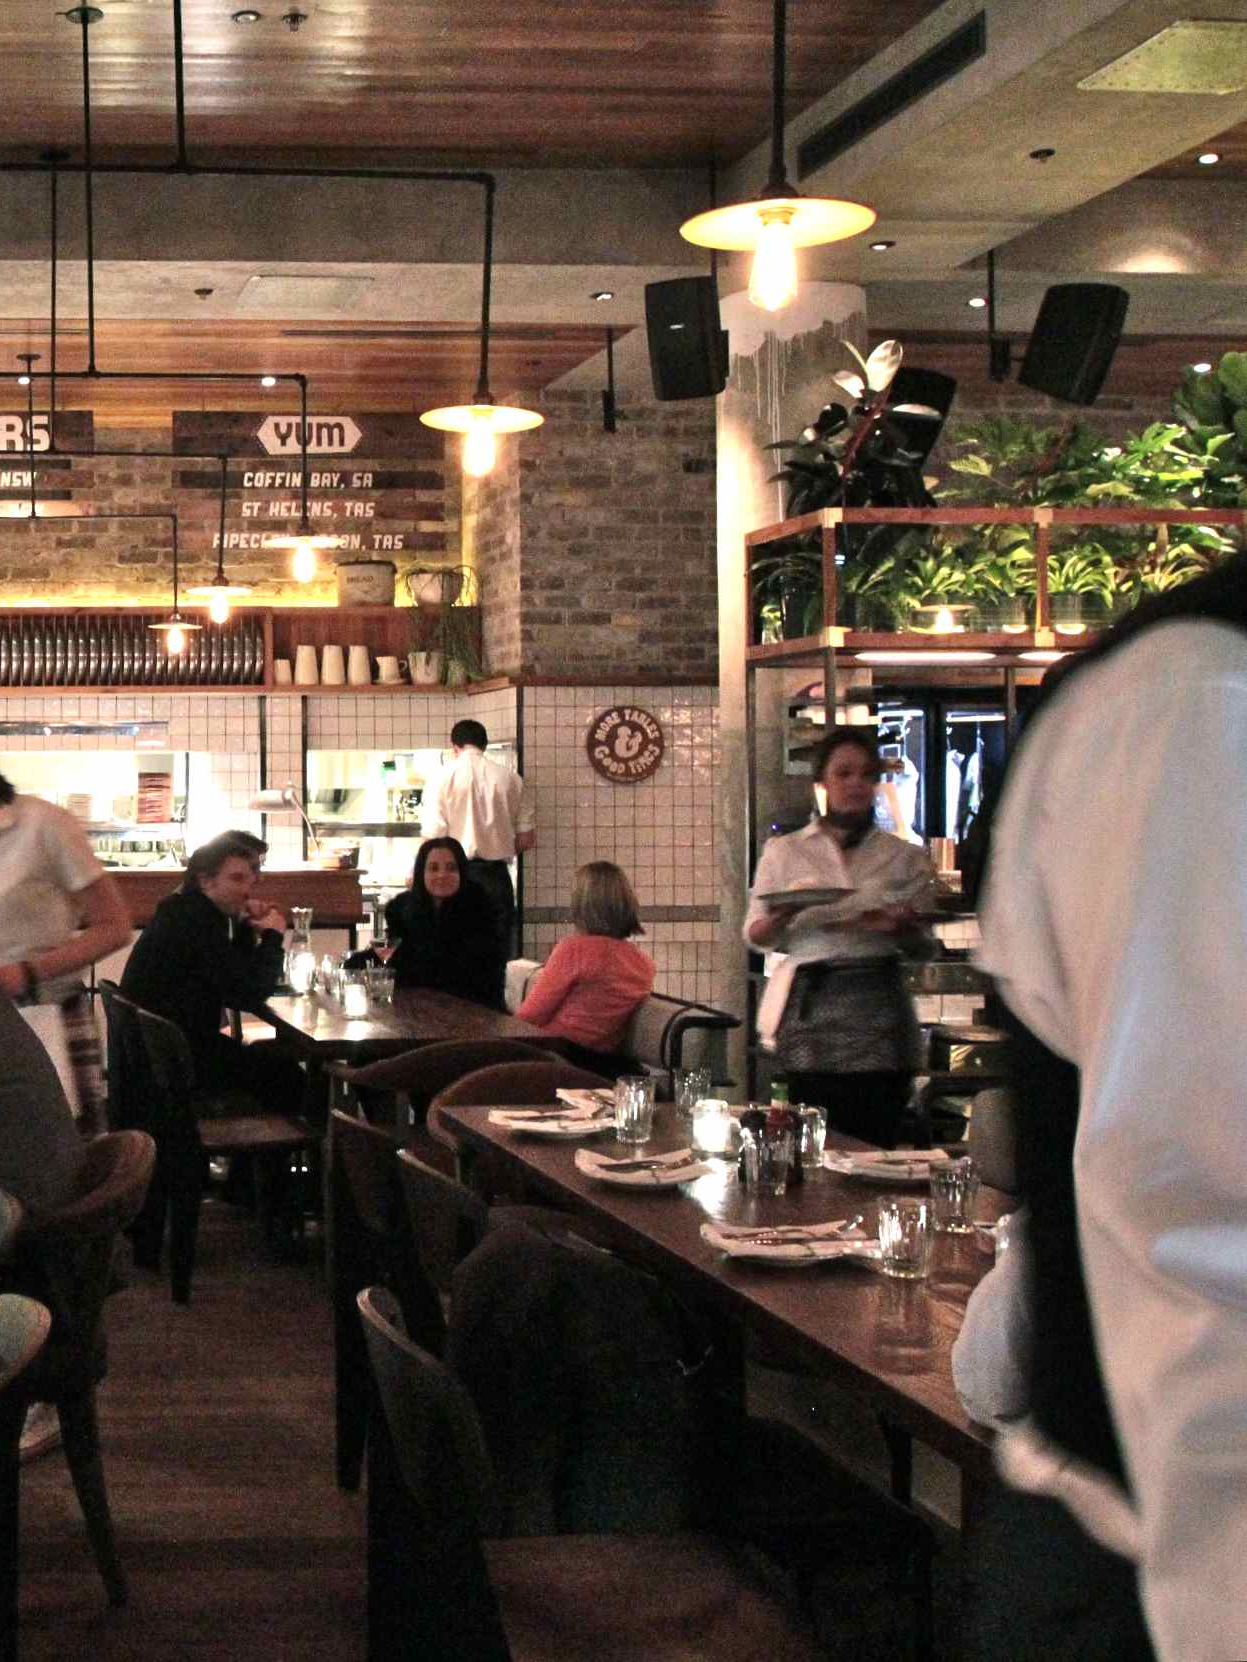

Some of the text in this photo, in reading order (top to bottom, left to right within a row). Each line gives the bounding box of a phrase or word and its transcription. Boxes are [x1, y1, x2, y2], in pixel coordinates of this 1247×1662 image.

[0, 472, 37, 488] NSW
[243, 471, 373, 489] COFFIN BAY, SA
[242, 501, 261, 517] ST
[344, 502, 375, 517] TAS
[373, 534, 404, 550] TAS
